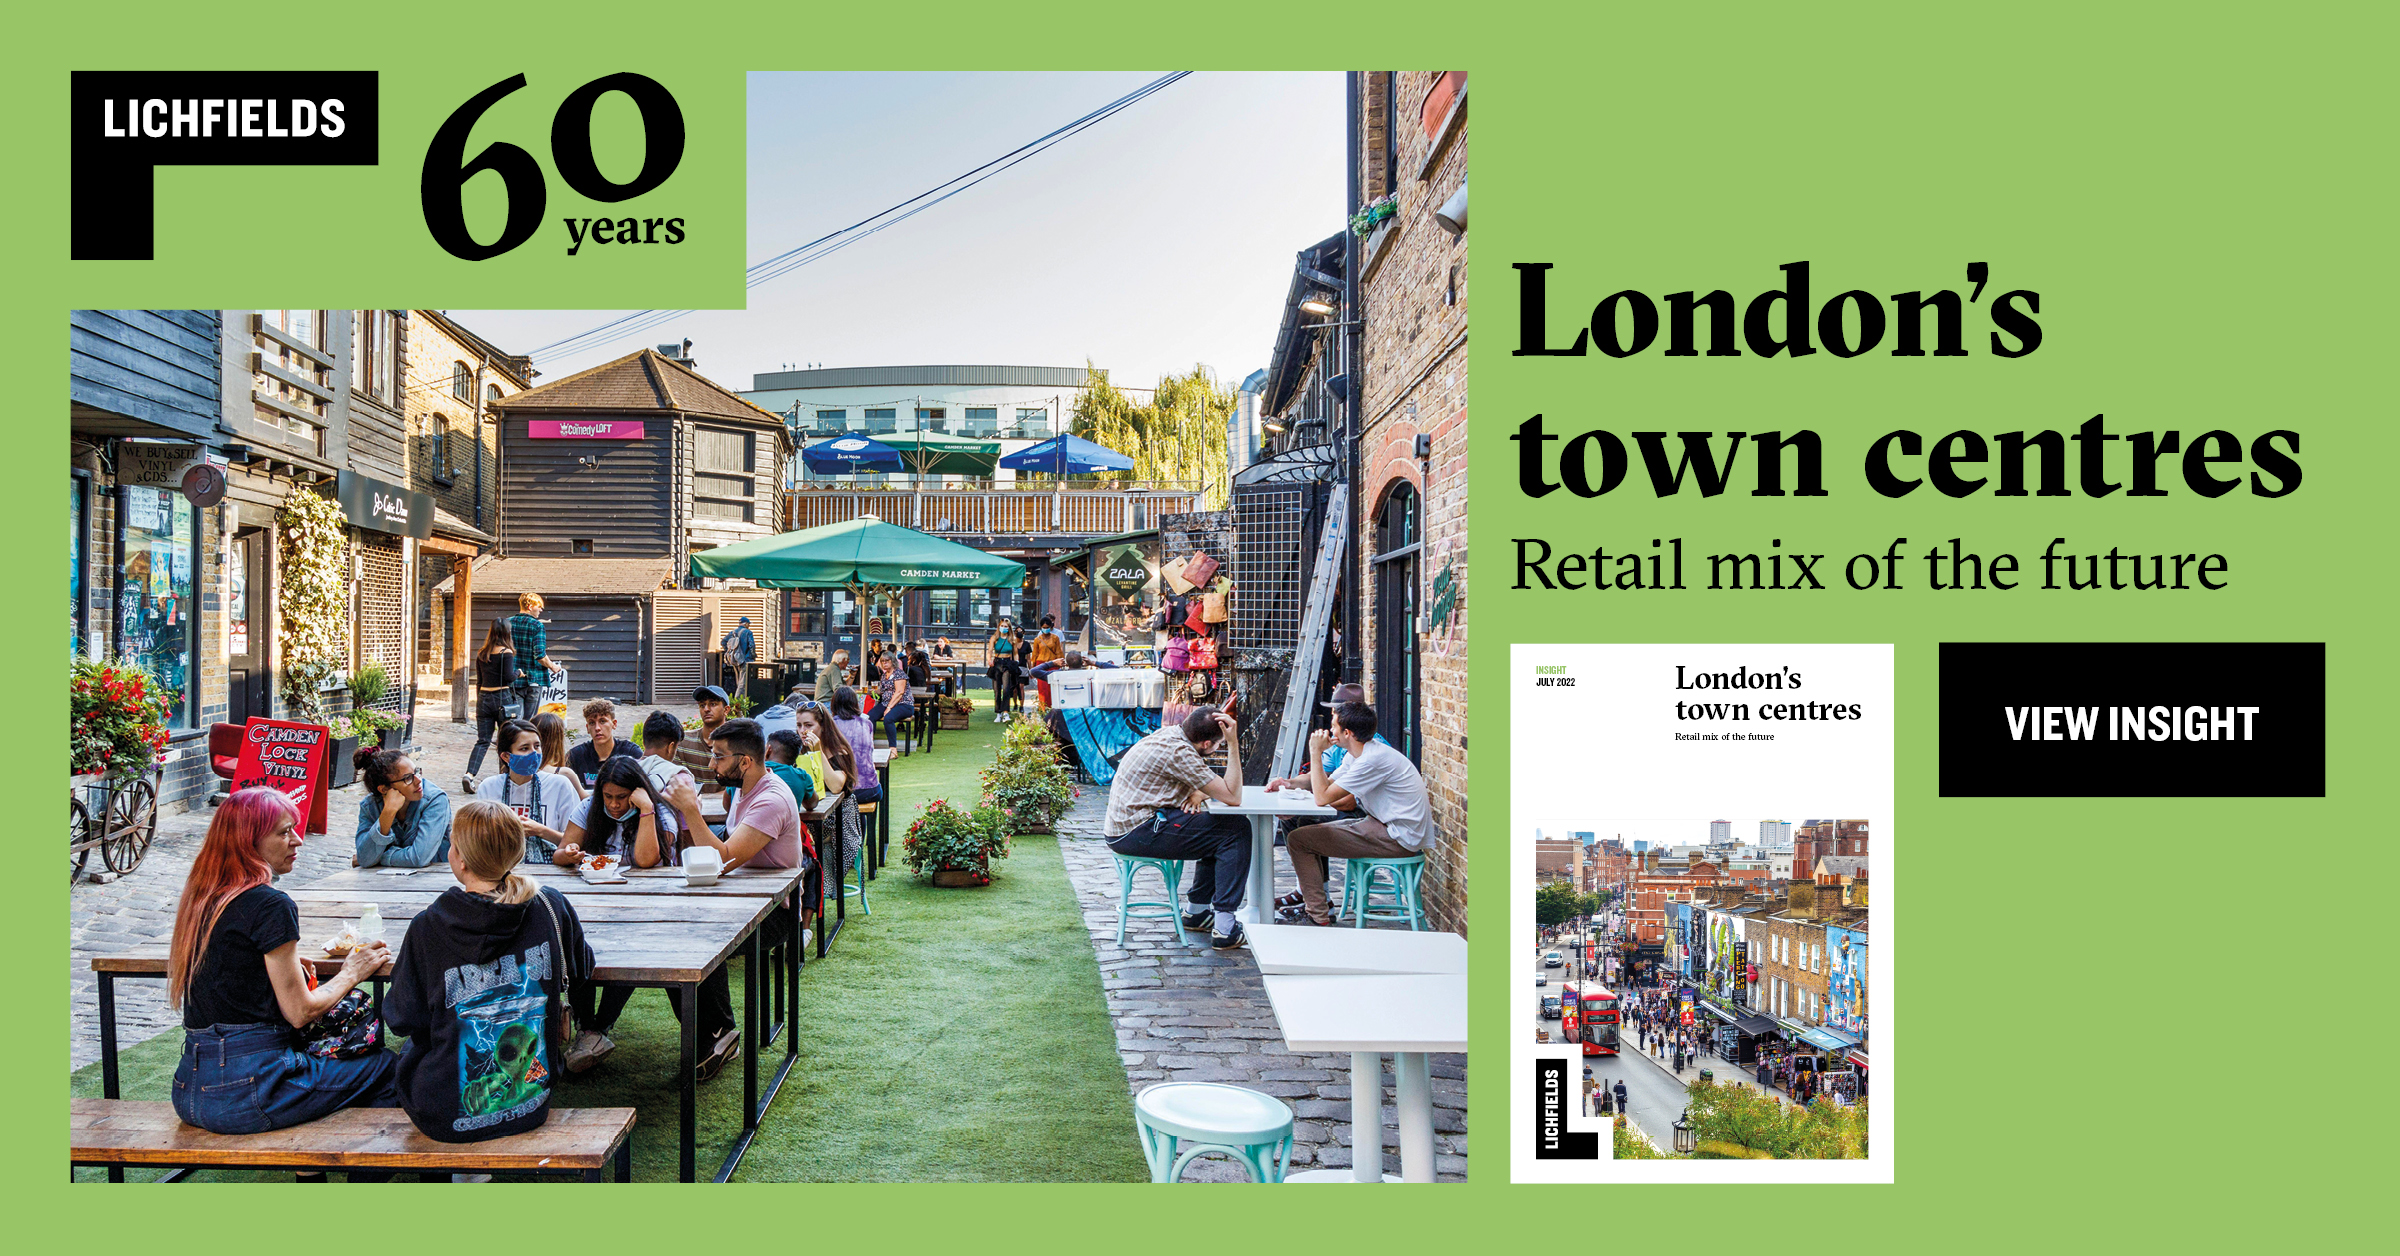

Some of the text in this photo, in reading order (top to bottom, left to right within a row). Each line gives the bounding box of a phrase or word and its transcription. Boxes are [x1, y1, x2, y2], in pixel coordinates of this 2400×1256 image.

[568, 422, 612, 437] Comedy LOFT
[124, 446, 142, 458] WE
[139, 460, 176, 472] VINYL
[900, 569, 981, 579] CAMDEN MARKET
[1109, 568, 1145, 580] ZALA
[550, 671, 564, 684] SH
[541, 688, 567, 702] HIPS
[248, 723, 322, 745] CAMDEN
[258, 742, 310, 764] LOCK
[263, 760, 308, 780] VINYL
[445, 941, 552, 1009] AREA 51
